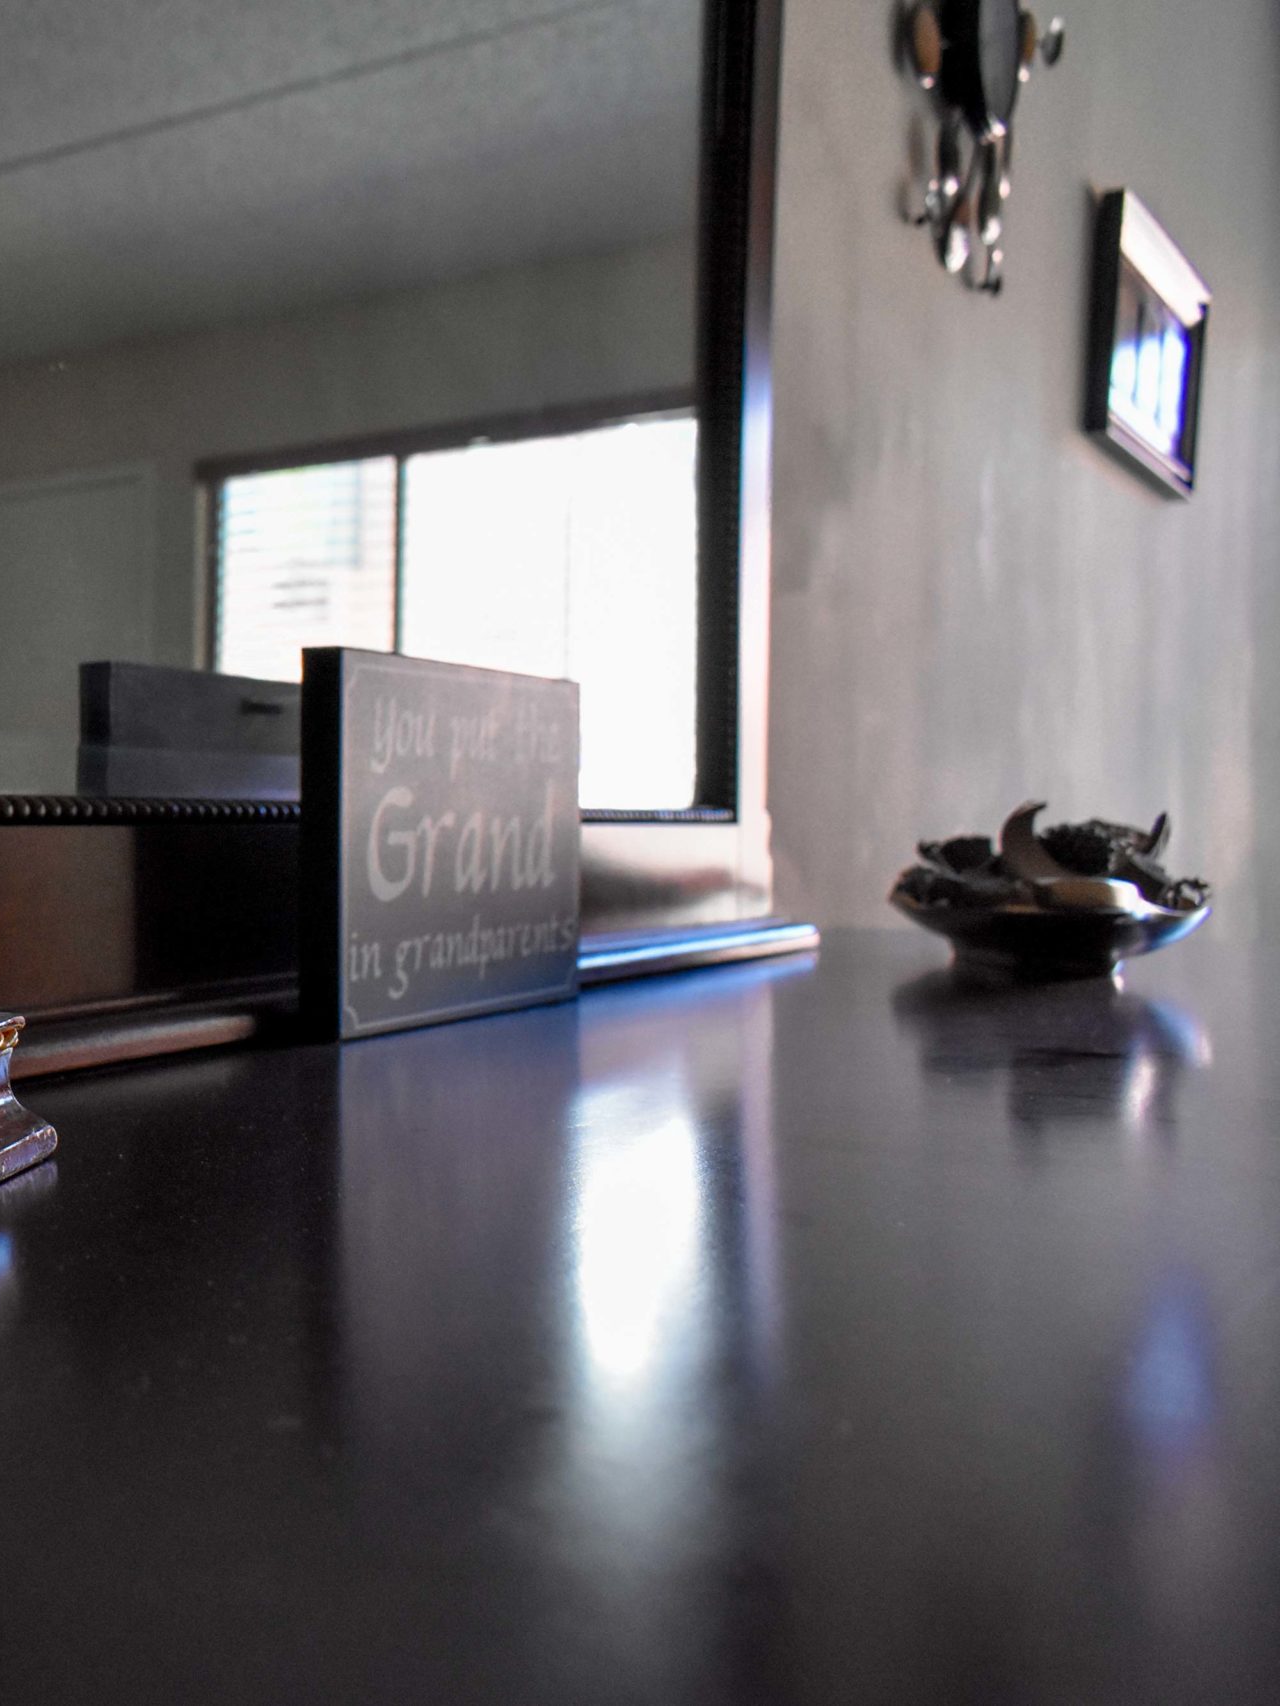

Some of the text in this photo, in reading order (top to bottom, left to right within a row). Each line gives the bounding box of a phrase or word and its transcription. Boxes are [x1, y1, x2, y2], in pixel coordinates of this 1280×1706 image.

[370, 694, 562, 782] You put the
[366, 777, 558, 902] Grand
[348, 913, 578, 1000] in grandparents
